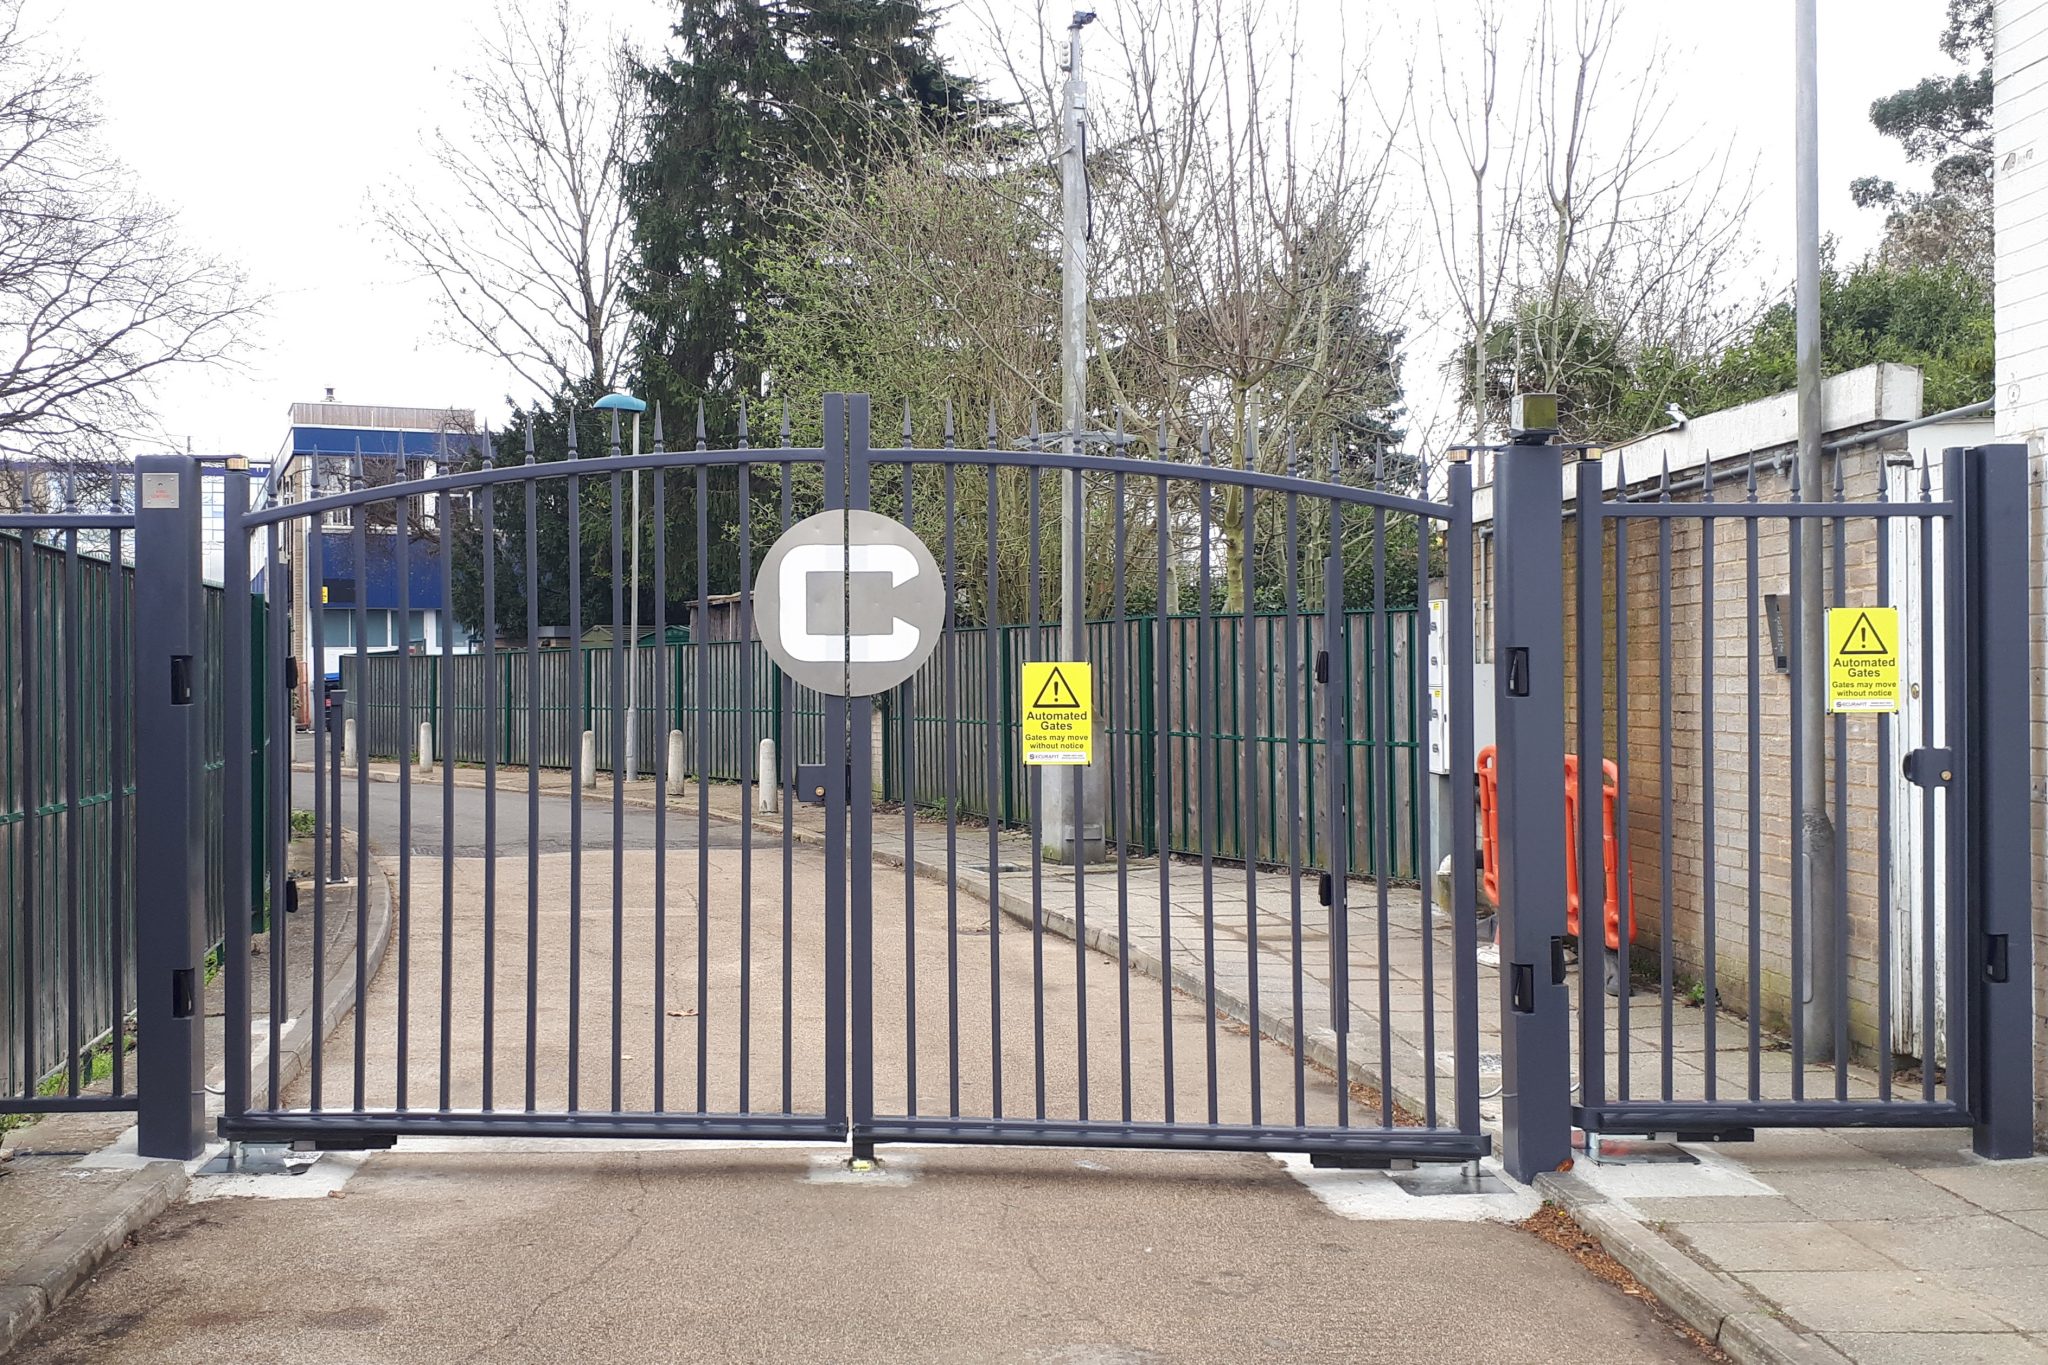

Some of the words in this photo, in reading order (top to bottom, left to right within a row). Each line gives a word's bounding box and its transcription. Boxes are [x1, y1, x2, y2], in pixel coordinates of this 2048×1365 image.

[779, 544, 920, 662] C
[1833, 657, 1895, 667] Automated
[1847, 668, 1881, 677] Gates
[1837, 689, 1866, 697] without
[1026, 711, 1087, 720] Automated
[1040, 721, 1073, 730] Gates
